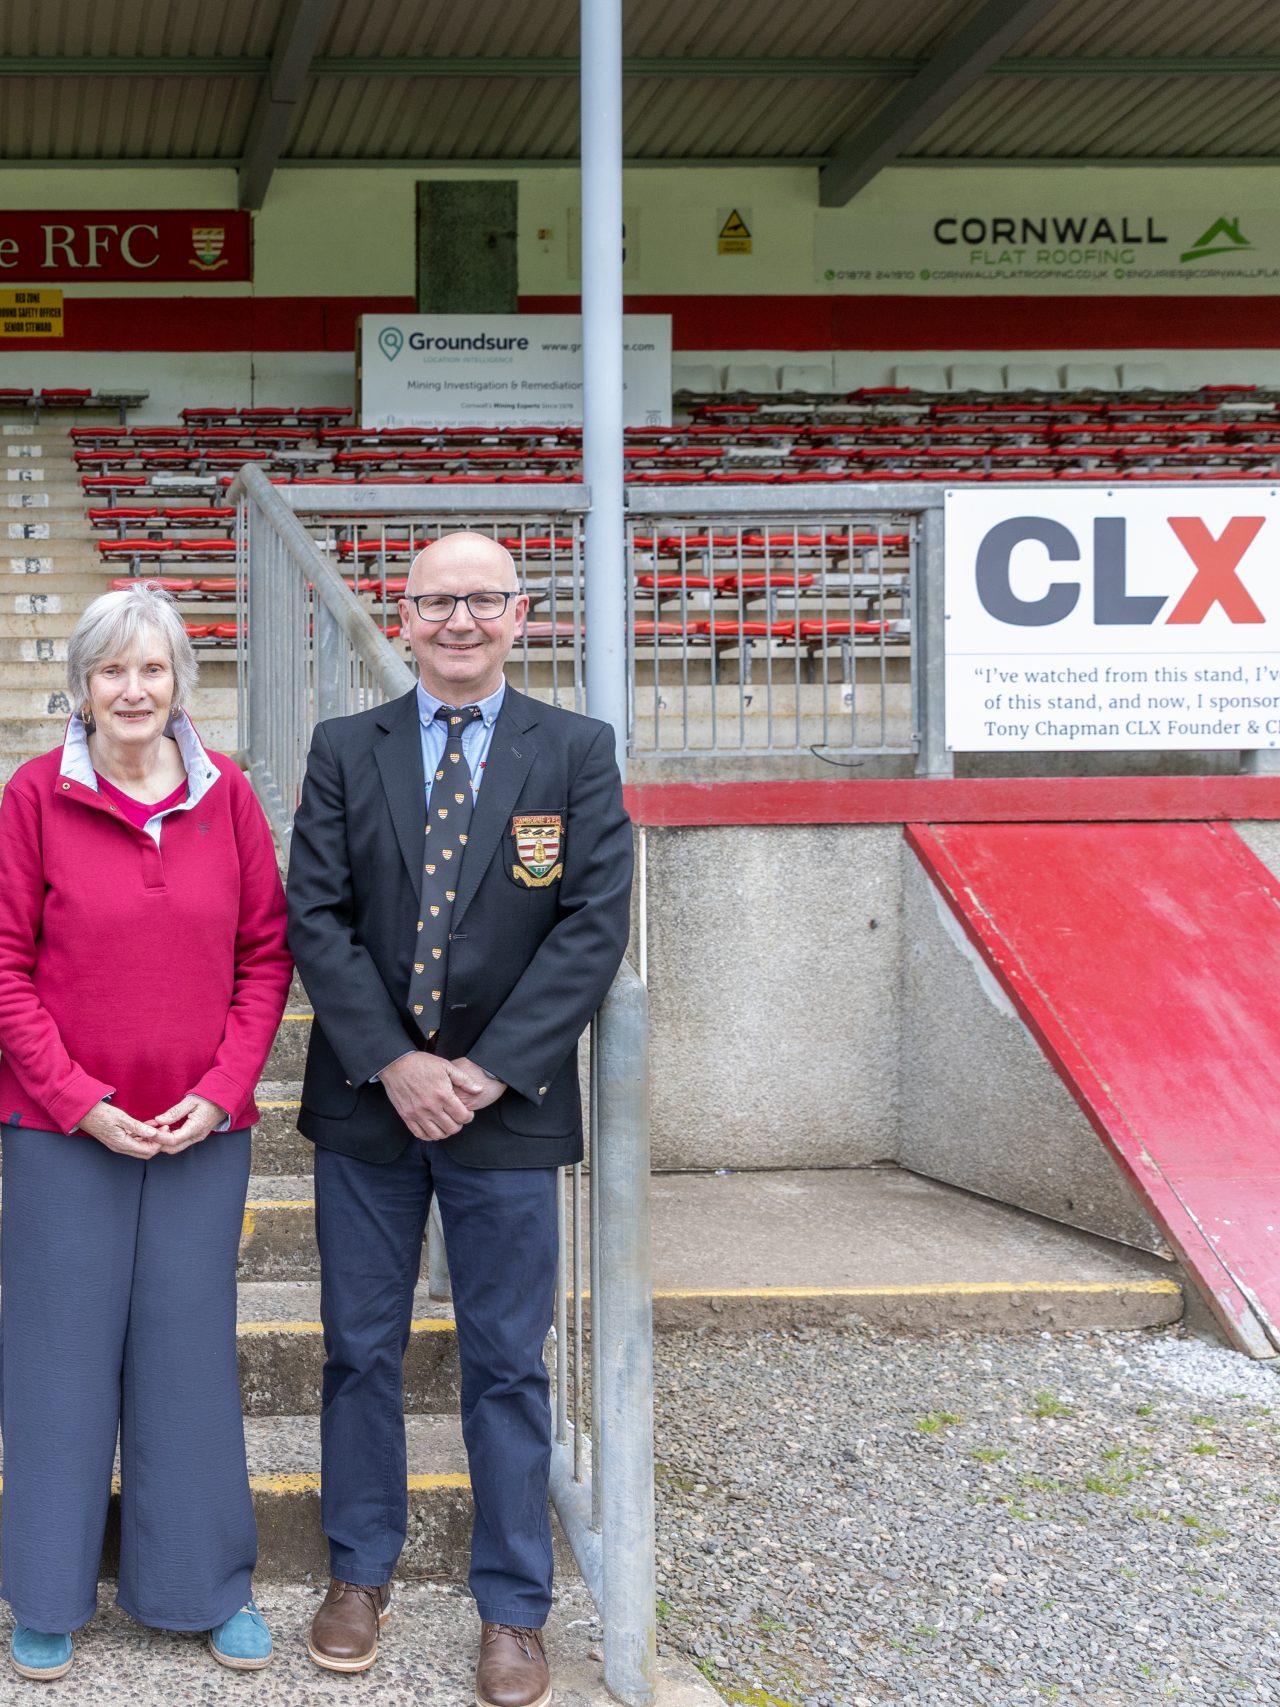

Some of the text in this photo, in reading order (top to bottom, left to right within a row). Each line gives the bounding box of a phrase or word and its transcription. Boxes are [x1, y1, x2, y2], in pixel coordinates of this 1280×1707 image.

[934, 217, 1168, 244] CORNWALL
[40, 225, 161, 268] RFC
[970, 249, 1135, 264] FLAT ROOFING
[15, 293, 40, 303] RED ZONE
[18, 308, 38, 317] SAFETY
[39, 308, 61, 317] OFFICER
[4, 322, 52, 332] SENIOR STEWARD
[408, 332, 529, 351] Groundsure
[407, 380, 584, 392] Mining Investigation & Remediation
[493, 402, 516, 411] Mining
[975, 516, 1267, 627] CLX
[36, 639, 54, 661] B
[1024, 668, 1098, 683] watched
[1105, 668, 1148, 683] from
[1155, 667, 1188, 682] this
[1194, 666, 1249, 686] stand,
[743, 695, 753, 707] 7
[984, 695, 1005, 710] of
[1008, 695, 1041, 710] this
[1047, 695, 1103, 713] stand,
[1108, 694, 1141, 709] and
[1148, 698, 1191, 712] now,
[1197, 695, 1203, 709] I
[984, 720, 1280, 740] Tony Chapman CLX Founder & C
